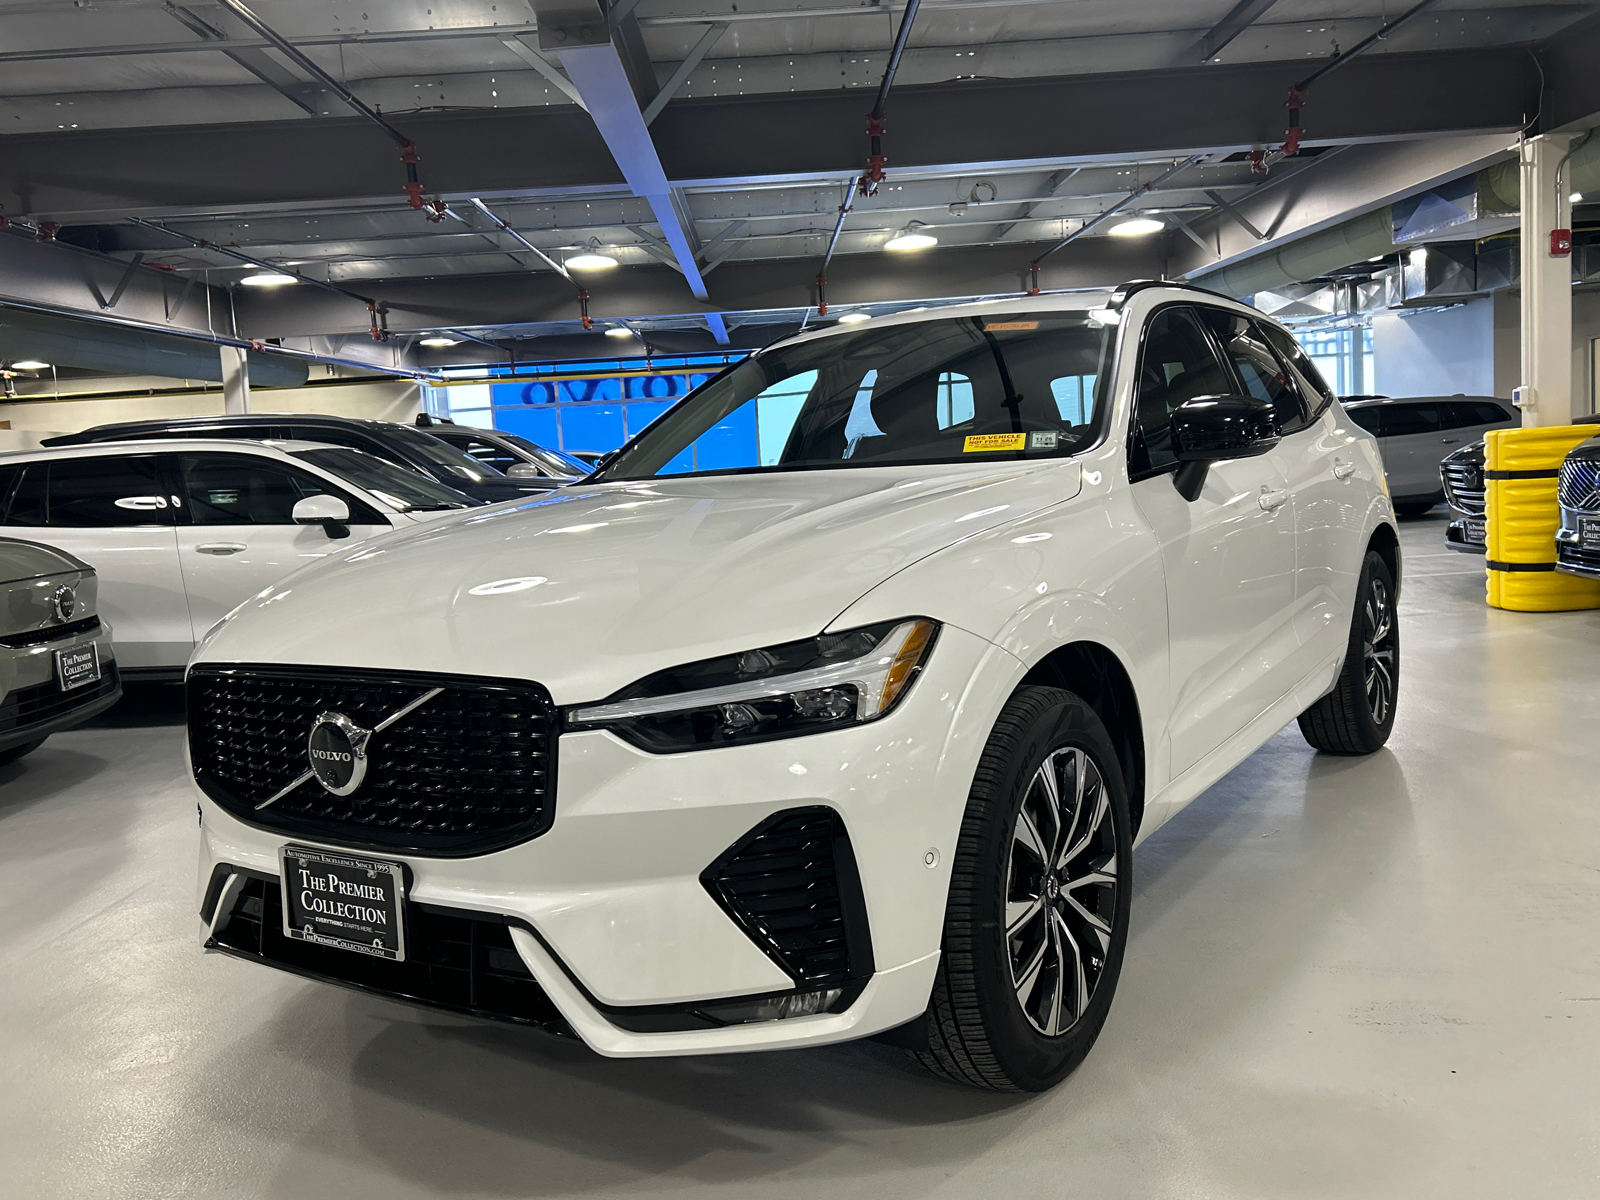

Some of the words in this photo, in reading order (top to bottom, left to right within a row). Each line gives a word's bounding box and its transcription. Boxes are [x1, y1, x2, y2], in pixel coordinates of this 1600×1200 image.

[62, 657, 73, 666] THE
[72, 652, 92, 664] PREMIER
[64, 661, 93, 676] COLLECTION
[312, 749, 351, 762] VOLVO
[286, 850, 320, 861] AUTOMOTIVE
[321, 854, 355, 867] EXCELLENCE
[355, 860, 373, 869] SINCE
[373, 863, 390, 873] 1995
[992, 817, 1010, 986] SCORPION
[1009, 741, 1036, 808] ZERO
[299, 869, 327, 892] THE
[327, 873, 386, 902] PREMIER
[301, 890, 387, 925] COLLECTION
[315, 916, 343, 927] EVERYTHING
[343, 921, 361, 931] STARTS
